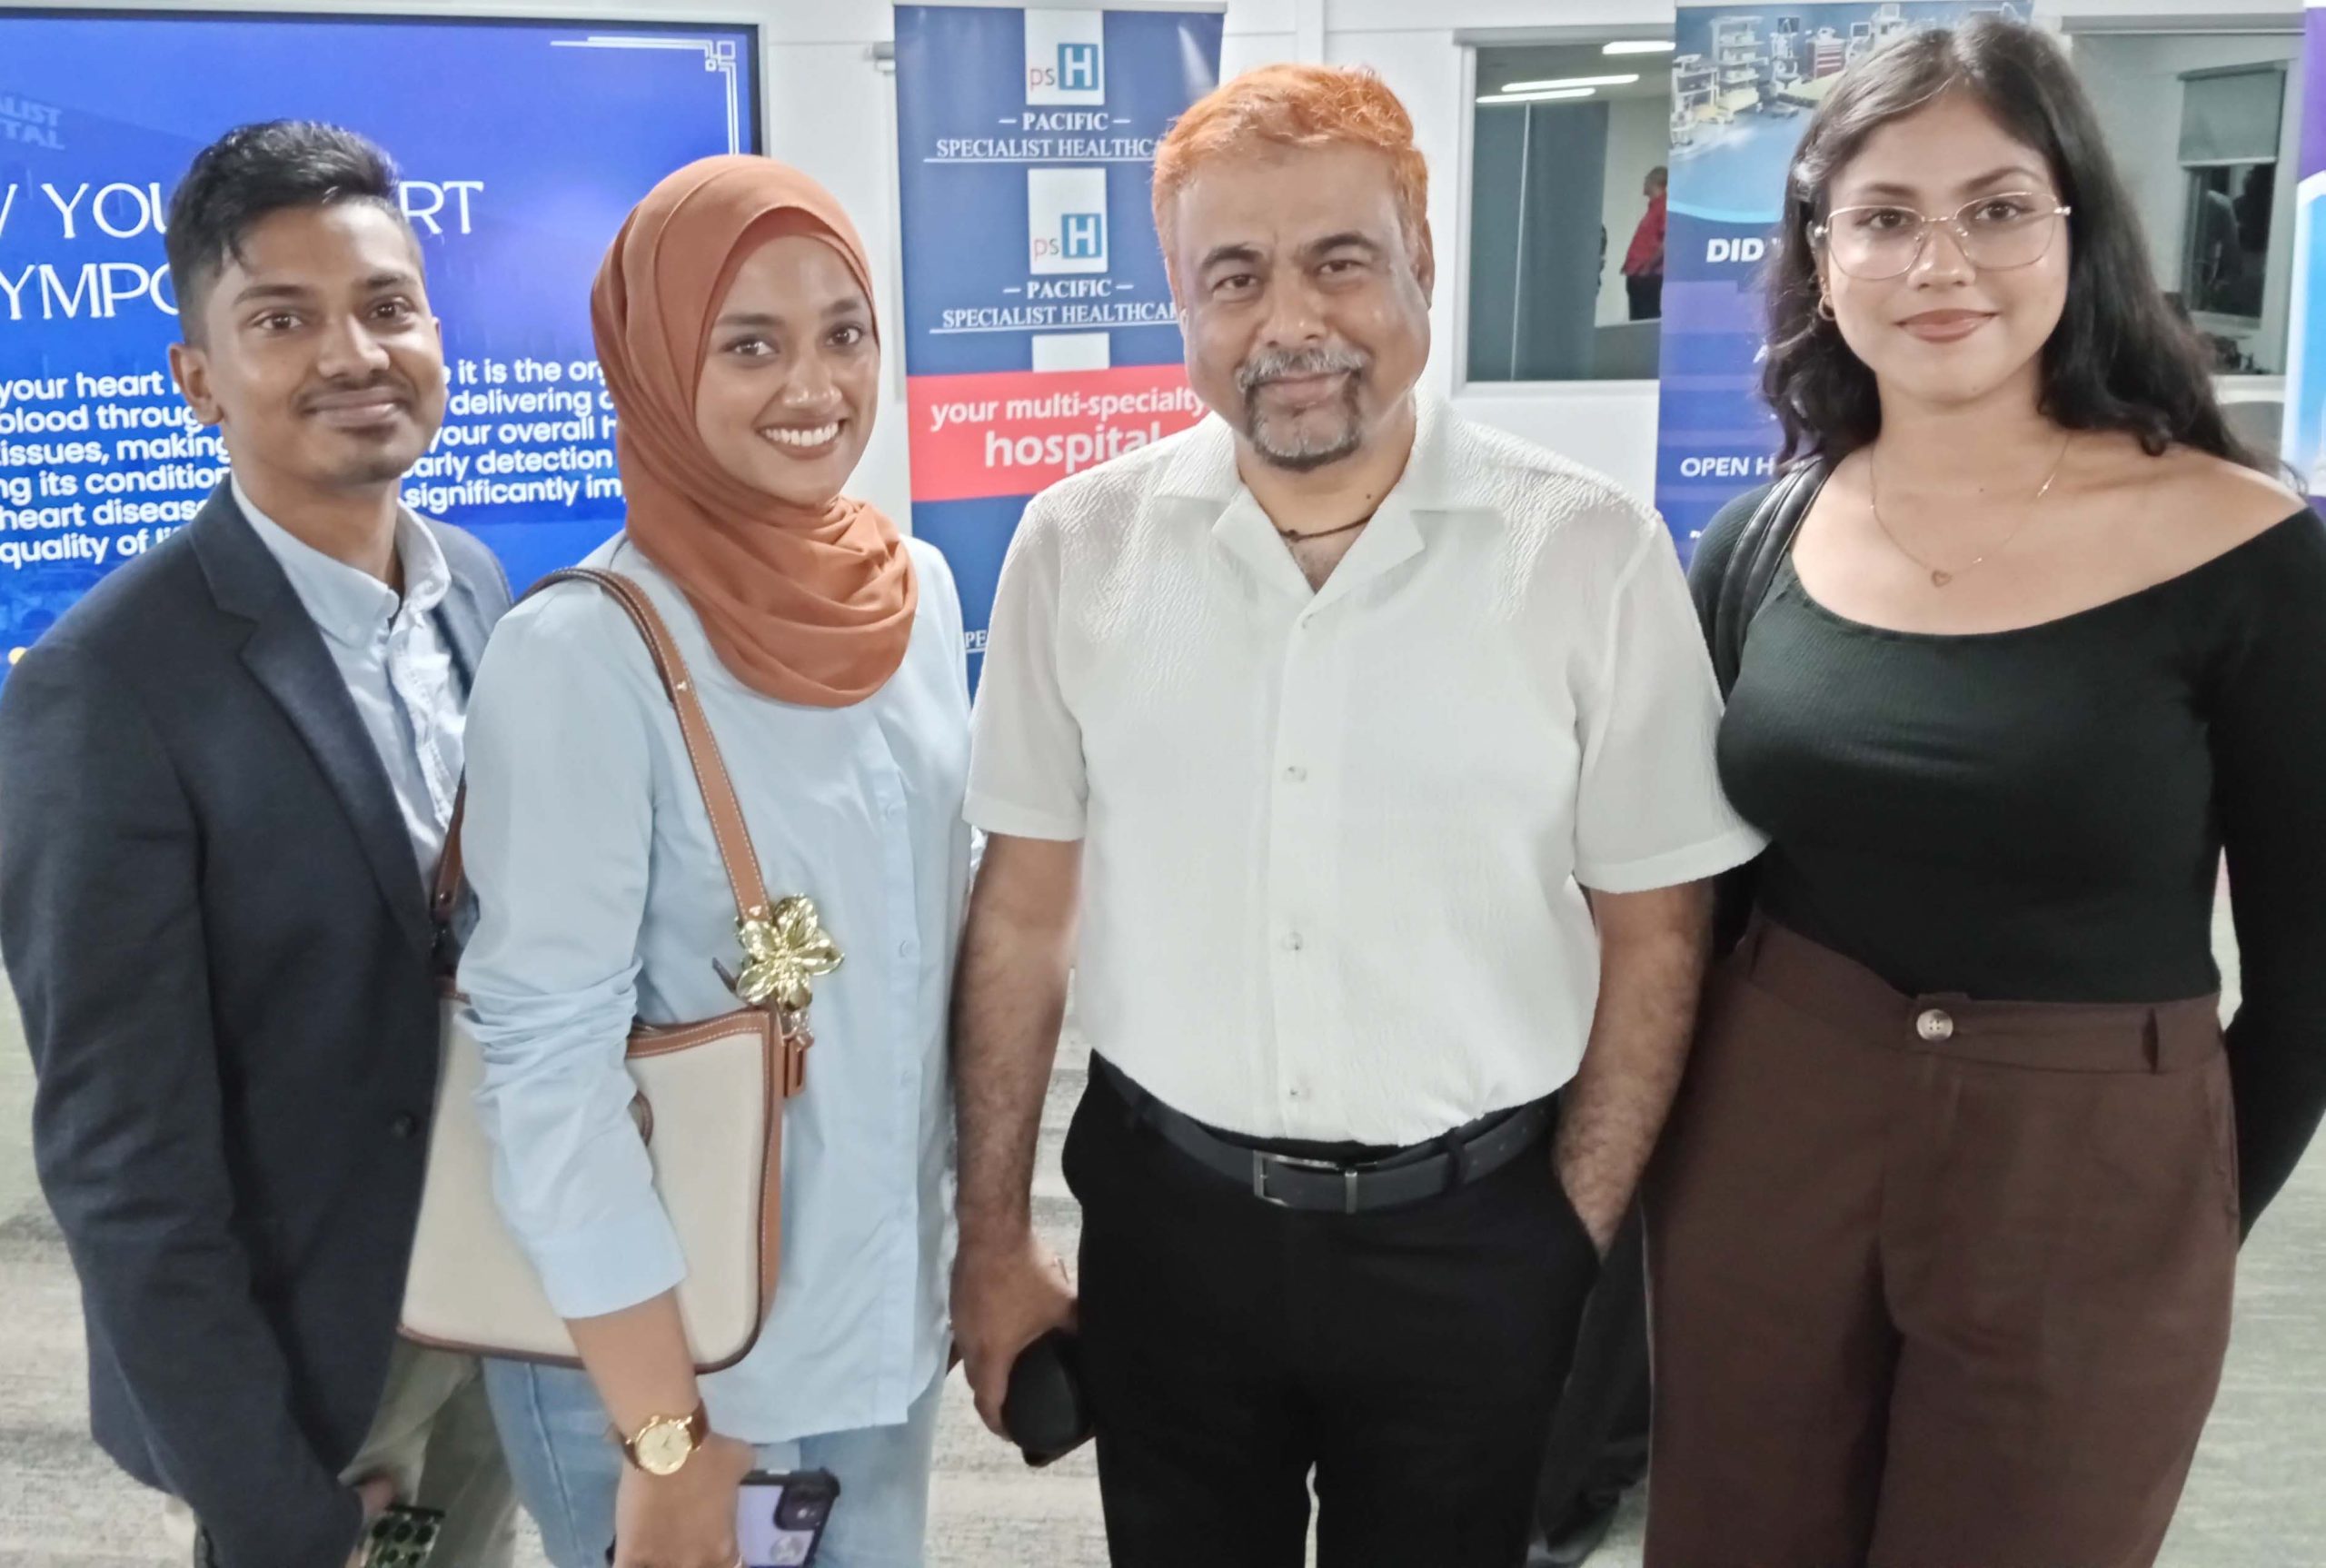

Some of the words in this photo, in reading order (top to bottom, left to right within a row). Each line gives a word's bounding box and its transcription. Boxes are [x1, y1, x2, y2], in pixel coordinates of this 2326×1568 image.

[0, 96, 62, 127] LIST
[1022, 112, 1108, 131] PACIFIC
[936, 138, 1052, 157] SPECIALIST
[1058, 137, 1156, 157] HEALTHC
[400, 180, 484, 235] RT
[1705, 237, 1764, 263] DID
[1027, 279, 1111, 299] PACIFIC
[942, 305, 1057, 328] SPECIALIST
[0, 378, 68, 408] your
[76, 371, 164, 399] heart
[458, 358, 478, 385] it
[483, 357, 508, 384] is
[514, 357, 562, 383] the
[96, 403, 204, 433] throug
[449, 387, 592, 417] delivering
[930, 400, 999, 432] your
[1006, 386, 1204, 422] multi-specialty
[0, 440, 109, 466] issues,
[116, 432, 232, 464] making
[498, 415, 595, 444] overall
[39, 470, 78, 497] its
[400, 452, 470, 483] arly
[475, 445, 614, 474] detection
[1680, 456, 1750, 477] OPEN
[1755, 456, 1775, 476] H
[0, 502, 86, 531] heart
[403, 475, 579, 514] significantly
[586, 473, 623, 499] im
[0, 532, 109, 571] quality
[116, 528, 149, 556] of
[964, 630, 988, 648] PE
